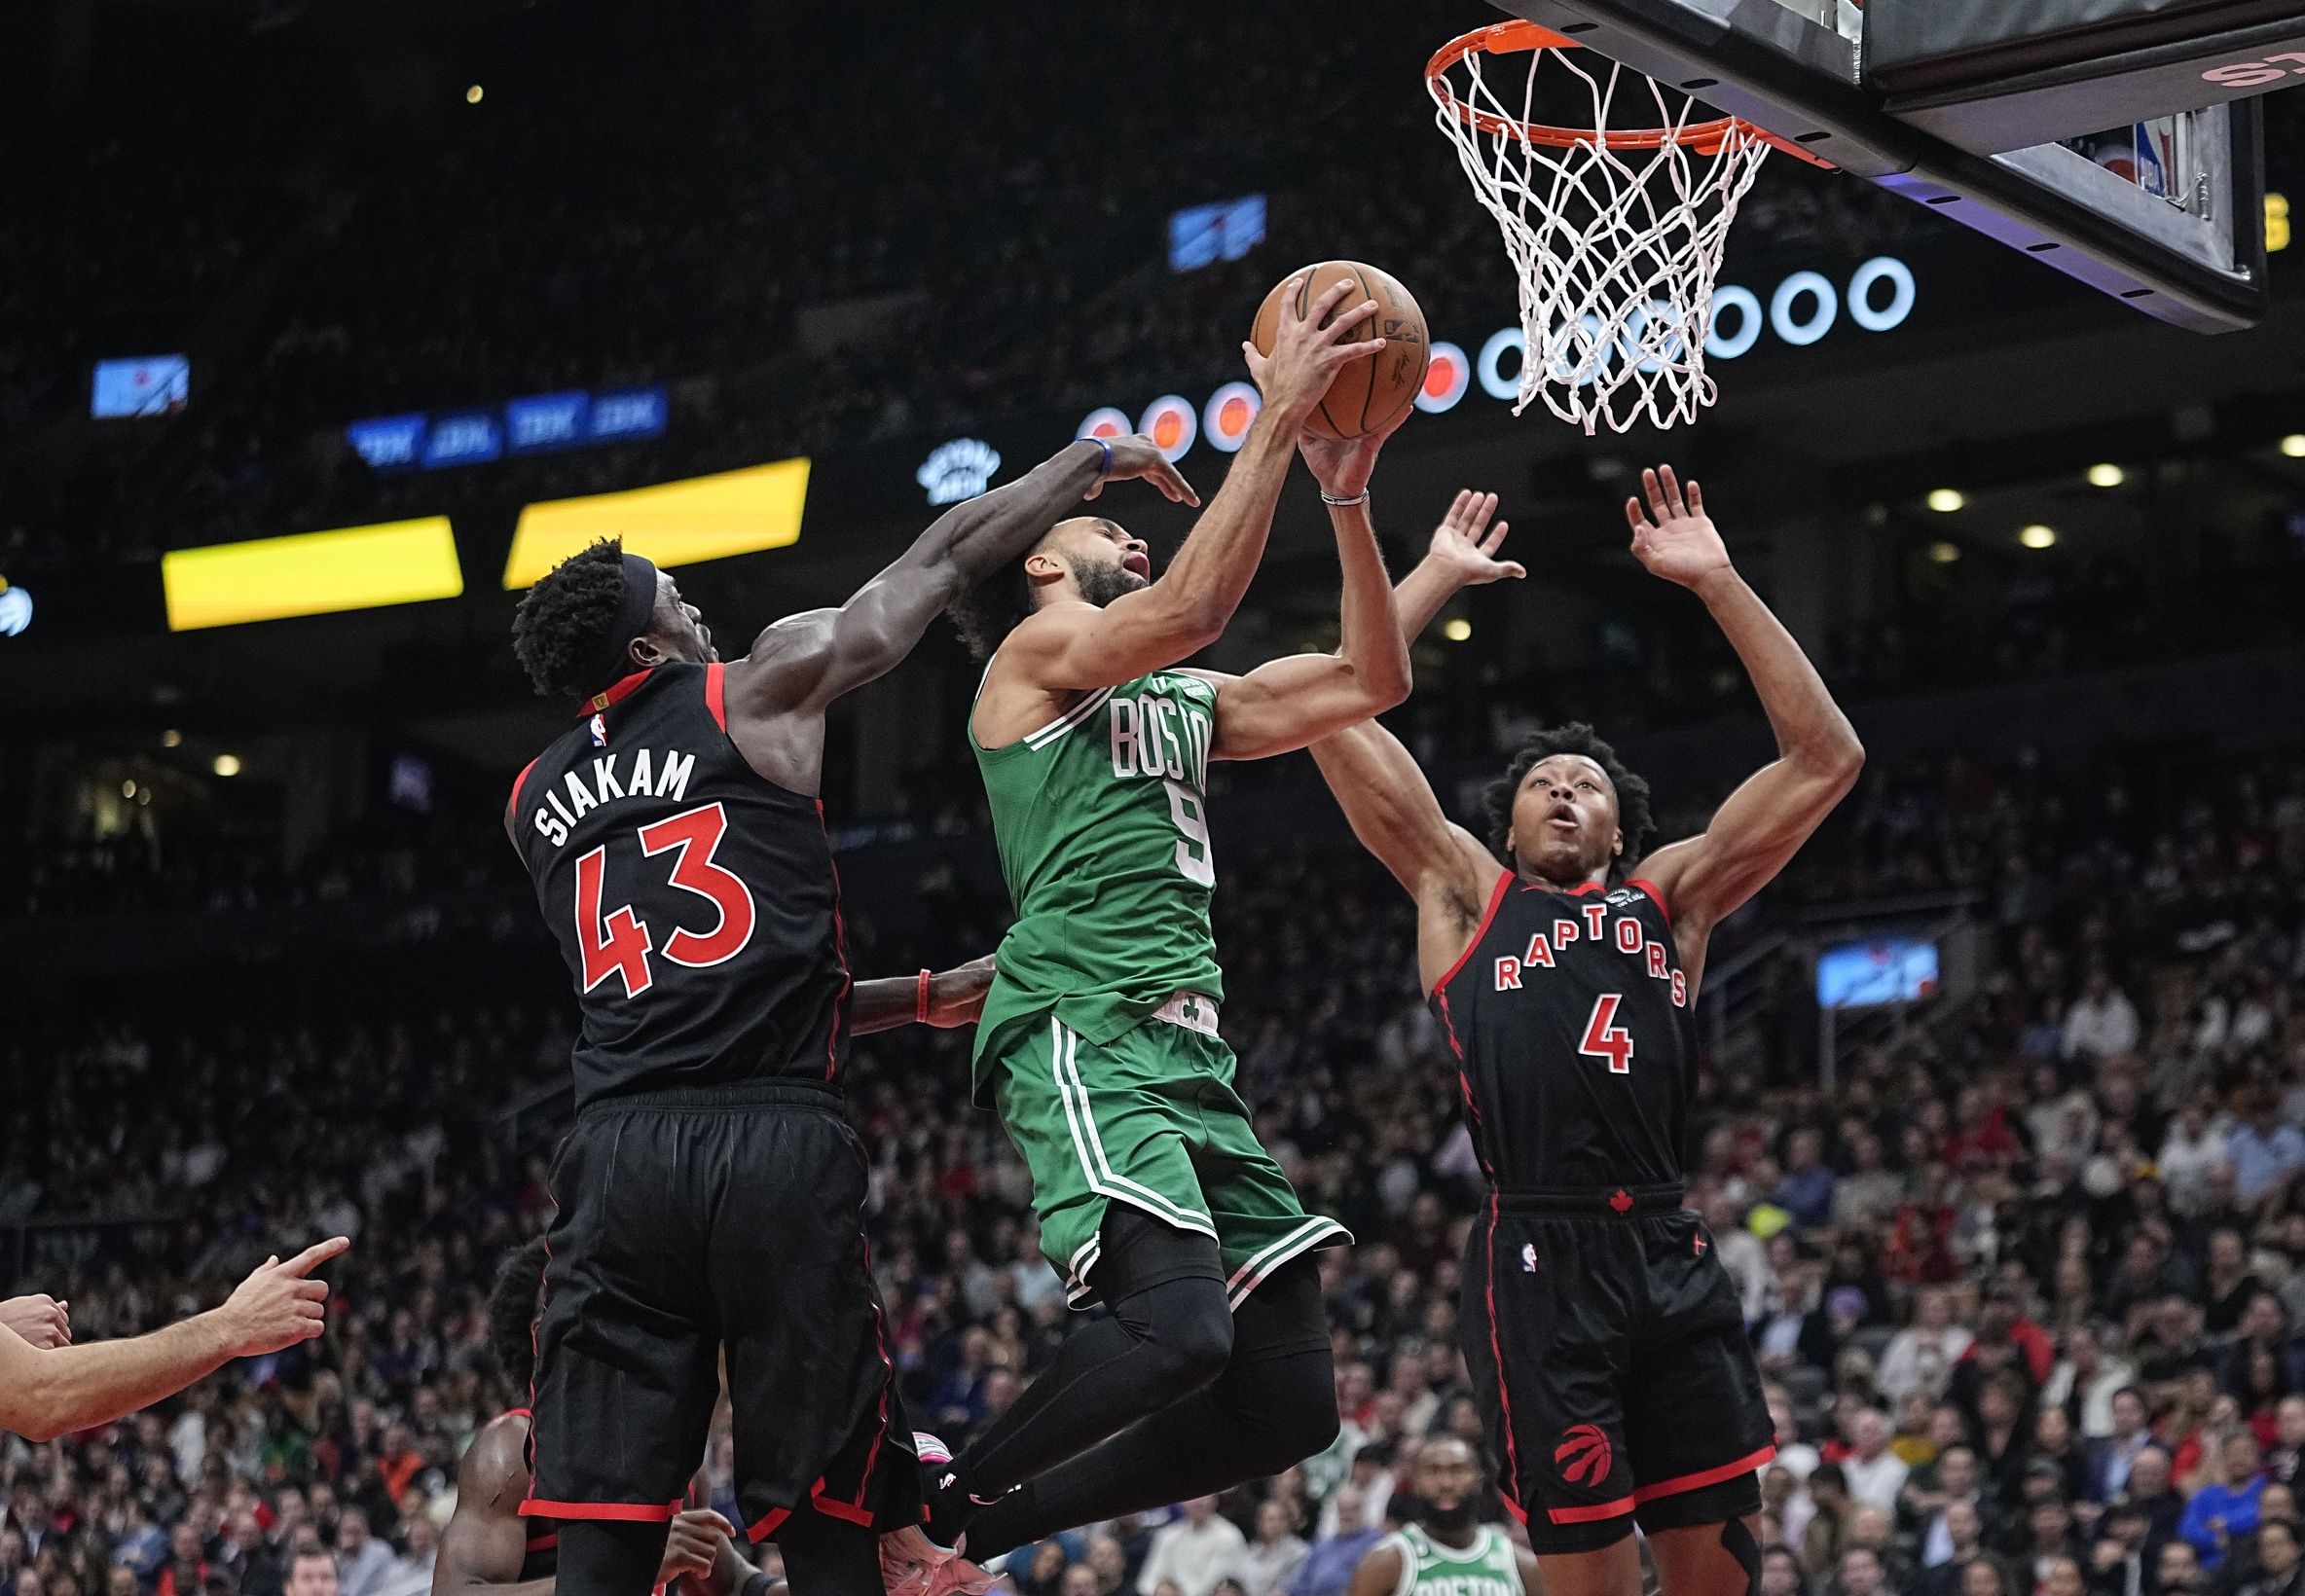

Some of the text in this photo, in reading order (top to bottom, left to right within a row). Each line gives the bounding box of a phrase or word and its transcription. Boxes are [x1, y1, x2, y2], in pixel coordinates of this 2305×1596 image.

[534, 747, 696, 848] SIAKAM
[1162, 780, 1217, 888] 9
[574, 801, 756, 1000] 43
[1493, 902, 1687, 1009] RAPTORS
[1578, 993, 1634, 1075] 4
